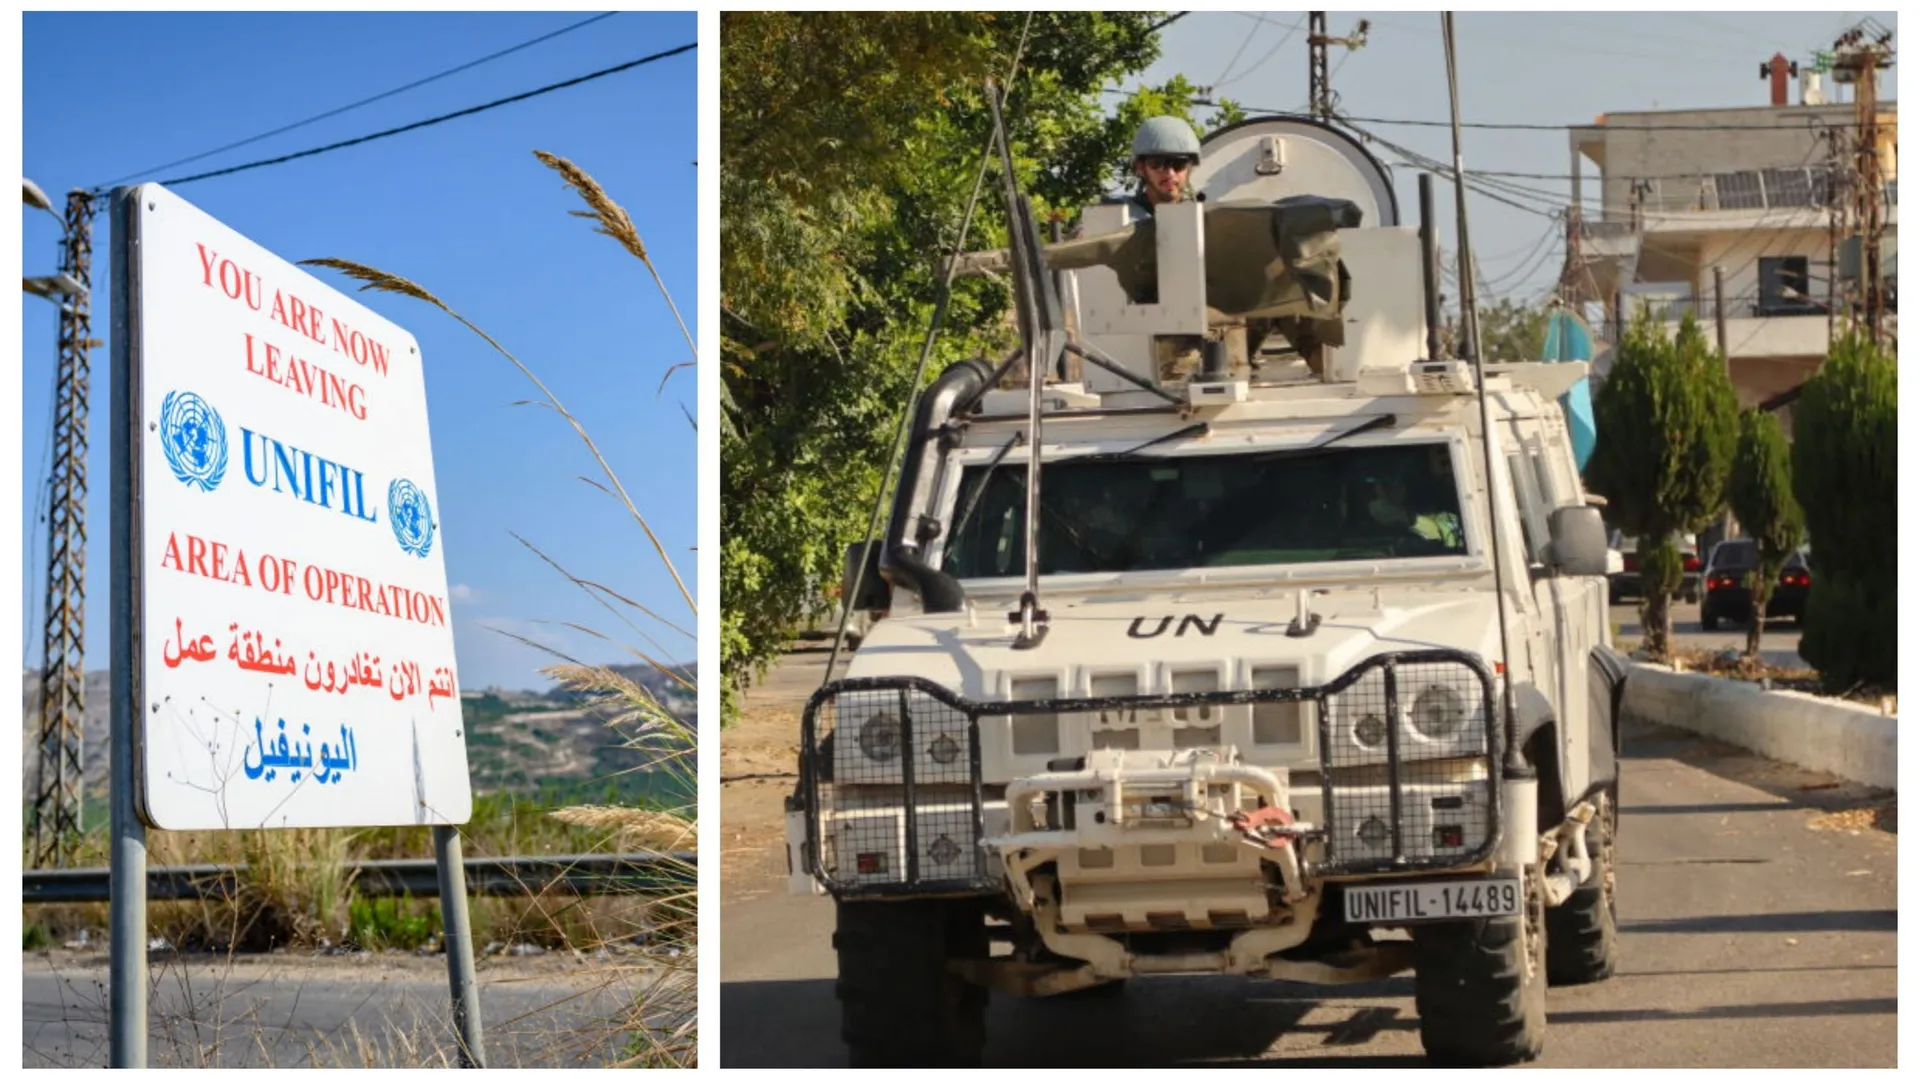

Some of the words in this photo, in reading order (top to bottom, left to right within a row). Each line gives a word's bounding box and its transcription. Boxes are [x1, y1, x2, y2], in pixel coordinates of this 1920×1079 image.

[195, 242, 262, 310] YOU
[270, 288, 325, 344] ARE
[331, 318, 390, 377] NOW
[243, 333, 367, 421] LEAVING
[239, 426, 377, 524] UNIFIL
[161, 530, 253, 588] AREA
[258, 553, 297, 595] OF
[303, 564, 446, 627] OPERATION
[163, 616, 217, 669] عمل
[227, 622, 297, 676] منطقة
[1126, 613, 1225, 639] UN
[304, 650, 383, 694] تغادرون
[389, 658, 422, 700] الان
[427, 666, 456, 712] انتم
[243, 715, 357, 785] اليونيفيل
[1350, 884, 1516, 919] UNIFIL-14489
